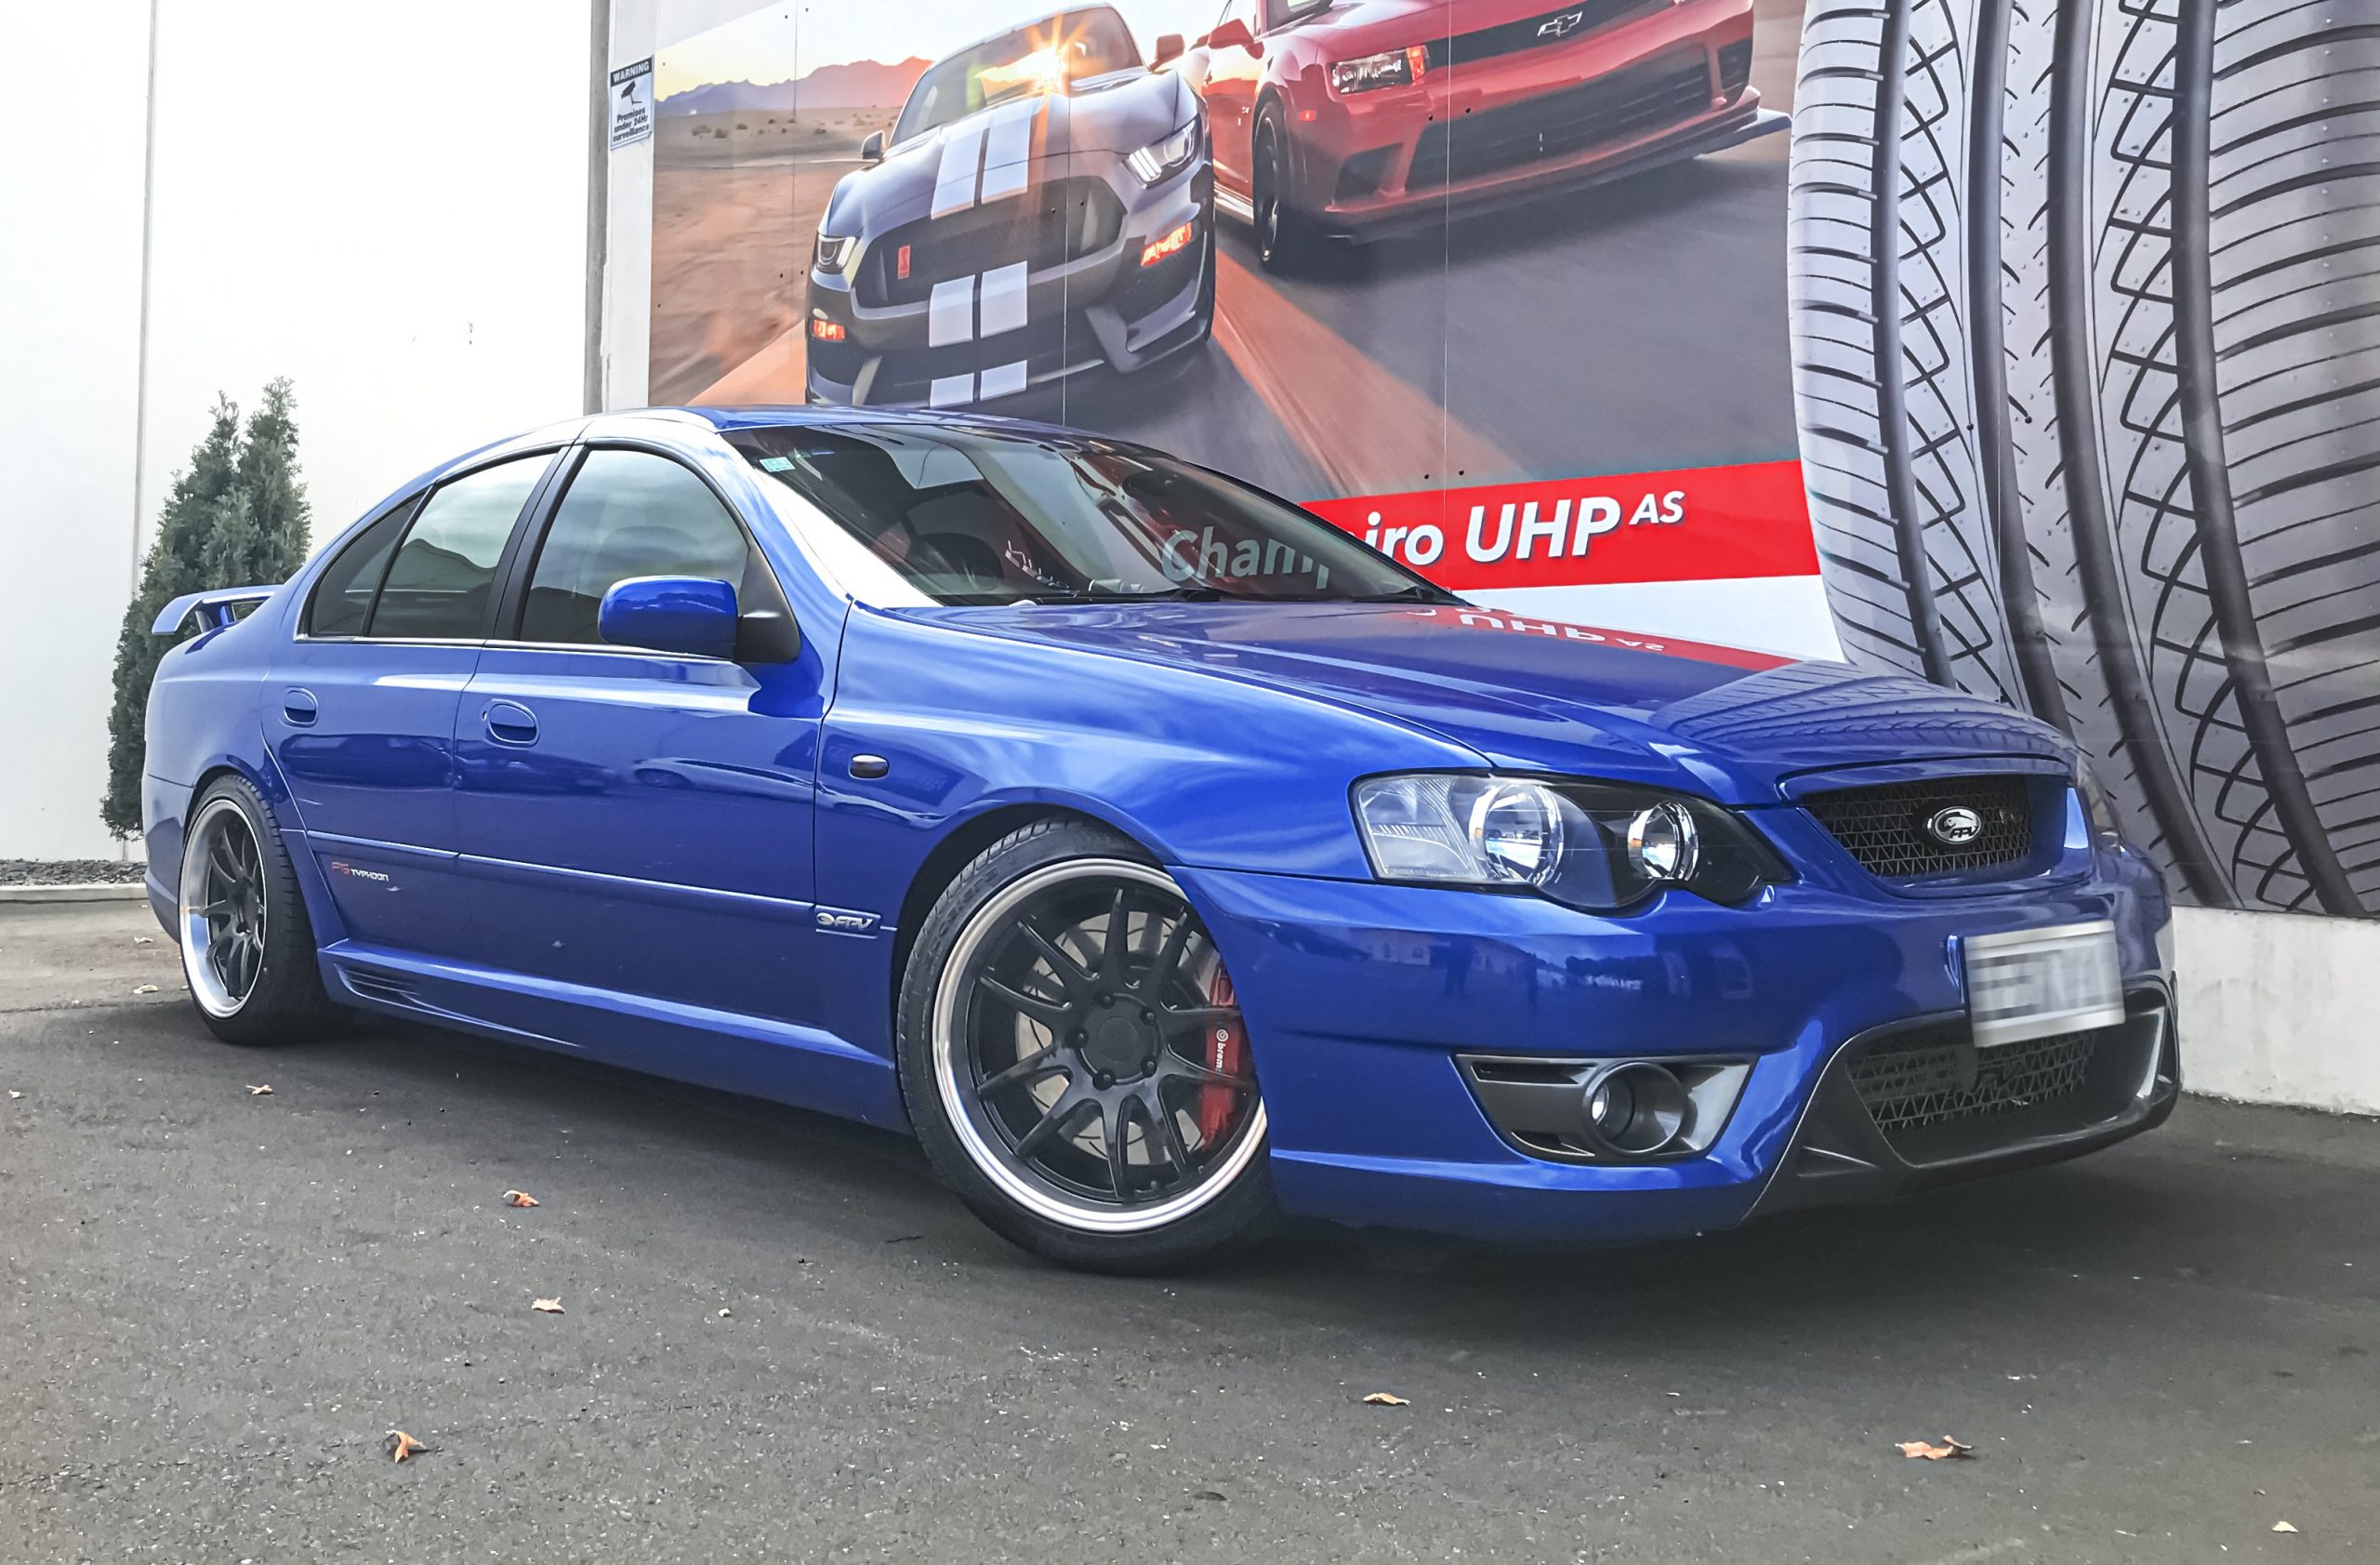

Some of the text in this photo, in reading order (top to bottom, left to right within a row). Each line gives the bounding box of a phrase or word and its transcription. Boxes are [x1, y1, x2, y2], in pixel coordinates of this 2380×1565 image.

[613, 60, 650, 83] WARNING
[616, 107, 646, 123] Premises
[613, 124, 650, 142] surveillance
[614, 121, 632, 133] under
[1465, 496, 1621, 563] UHP
[1629, 490, 1686, 525] AS
[1950, 825, 1979, 839] FPV
[350, 868, 390, 882] TYPHOON
[833, 915, 874, 931] FPV
